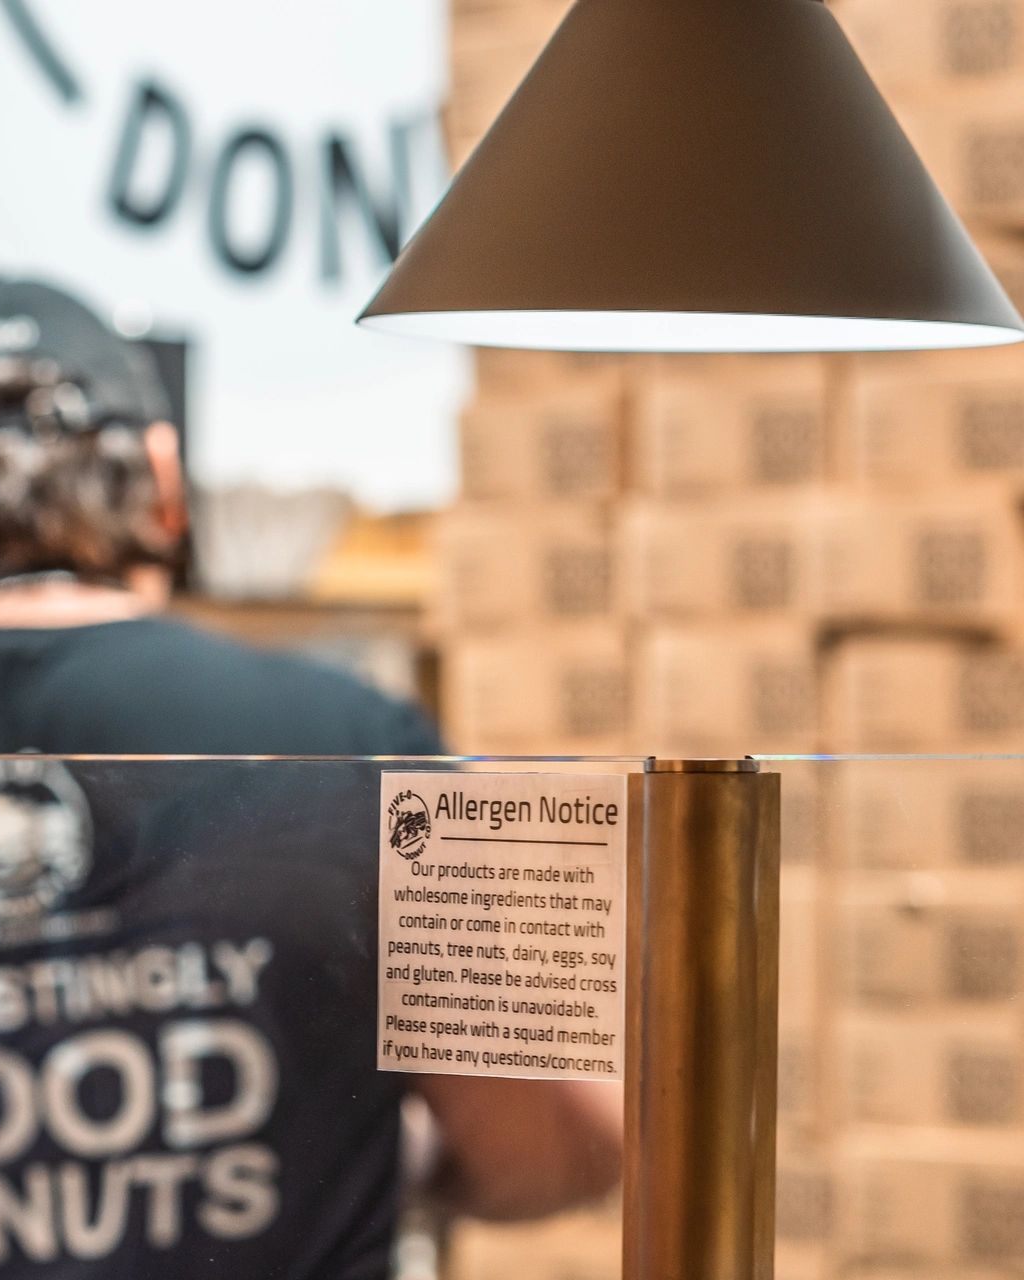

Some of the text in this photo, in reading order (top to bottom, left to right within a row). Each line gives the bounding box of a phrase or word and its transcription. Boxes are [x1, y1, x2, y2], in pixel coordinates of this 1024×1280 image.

[435, 793, 618, 830] Allergen Notice
[406, 843, 427, 860] DONUT
[411, 862, 594, 883] Our products are made with
[394, 887, 611, 915] wholesome ingredients that may
[399, 914, 605, 938] contain or come in contact with
[388, 940, 615, 970] peanuts, tree nuts, dairy, eggs, soy
[386, 965, 616, 993] and gluten. Please be advised cross
[402, 992, 599, 1018] contamination is unavoidable.
[386, 1016, 615, 1046] Please speak with a squad member
[383, 1040, 617, 1074] if you have any questions/concerns.
